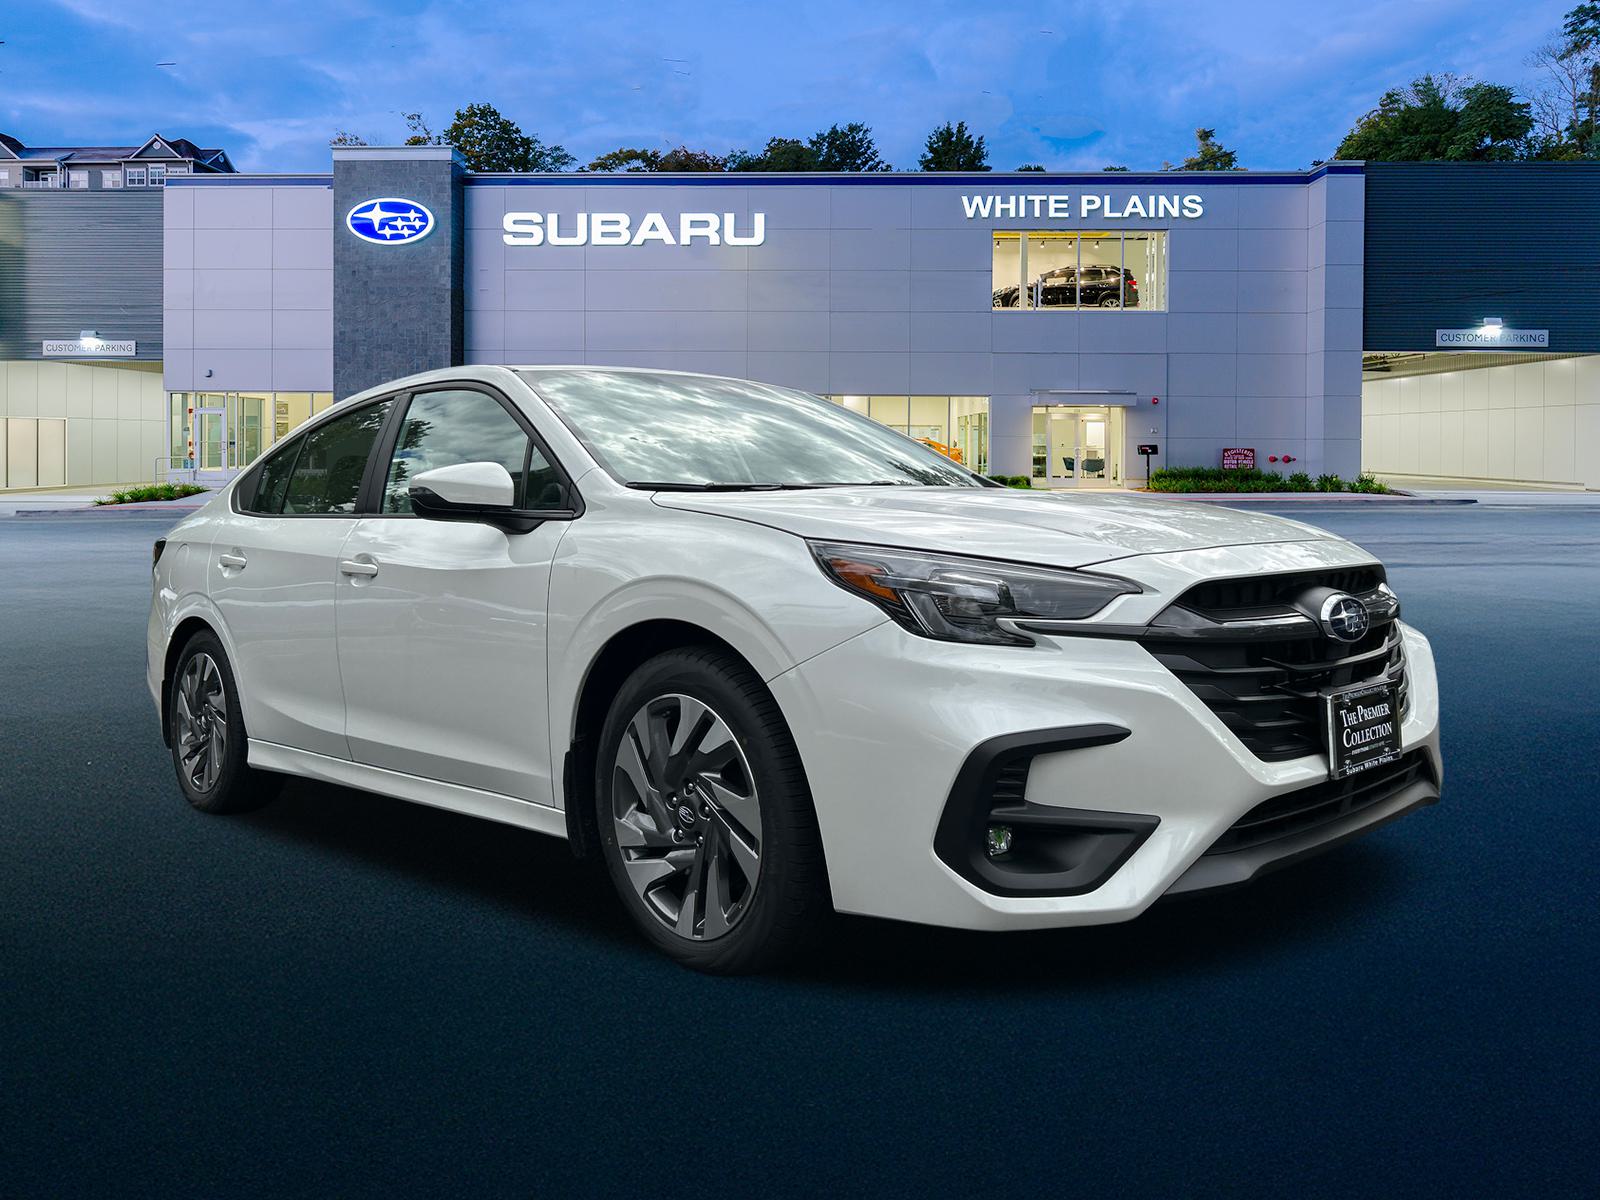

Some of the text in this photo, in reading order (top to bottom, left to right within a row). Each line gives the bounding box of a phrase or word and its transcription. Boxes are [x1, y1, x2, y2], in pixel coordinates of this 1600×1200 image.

[961, 195, 1204, 218] WHITE PLAINS
[502, 211, 766, 247] SUBARU
[45, 343, 133, 352] CUSTOMER PARKING
[1440, 333, 1545, 343] CUSTOMER PARKING
[1340, 703, 1390, 727] THE PREMIER
[1343, 722, 1392, 748] COLLECTION
[1346, 755, 1393, 775] Subaru White Plains
